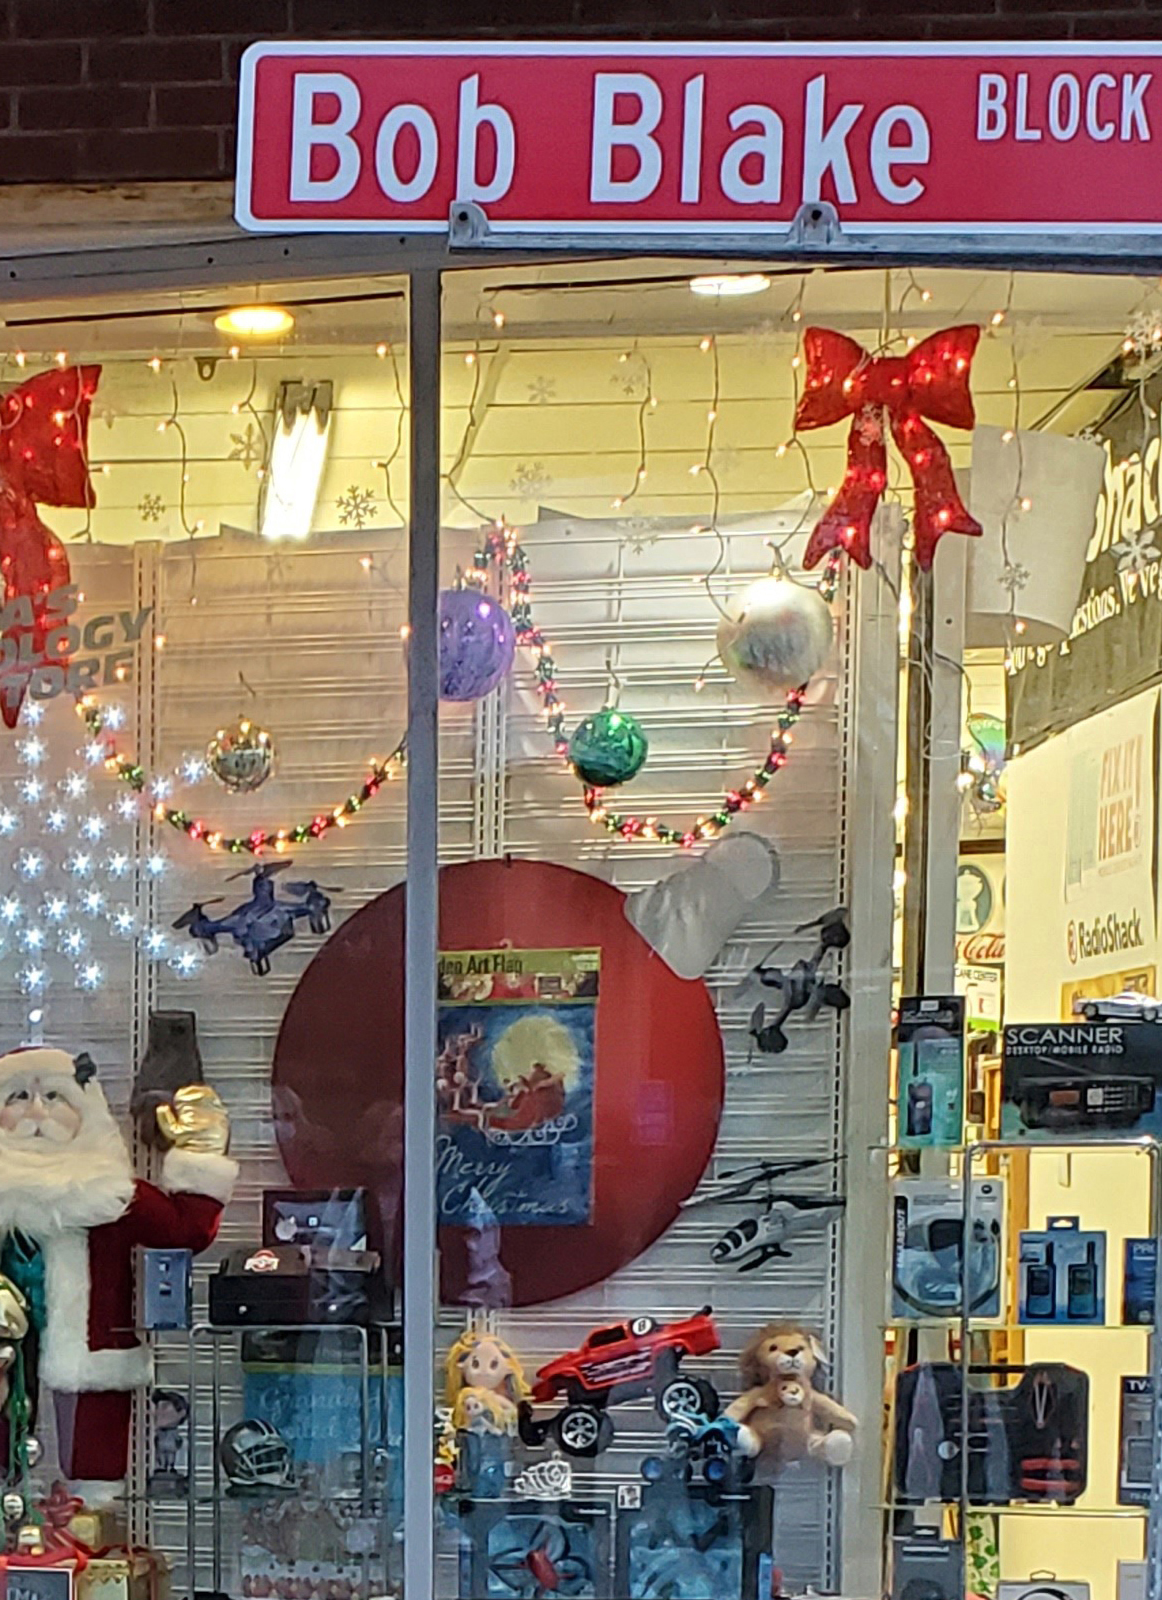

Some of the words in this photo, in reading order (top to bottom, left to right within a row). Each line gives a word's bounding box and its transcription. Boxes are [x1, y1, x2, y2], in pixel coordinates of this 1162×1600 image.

[289, 72, 515, 203] Bob
[589, 72, 931, 205] Blake
[977, 72, 1153, 142] BLOCK
[1078, 908, 1144, 959] RadioShack
[467, 955, 489, 974] Art
[493, 954, 523, 975] Flag
[1006, 1027, 1124, 1045] SCANNER
[436, 1135, 513, 1198] Merry
[442, 1178, 568, 1214] Chistmas
